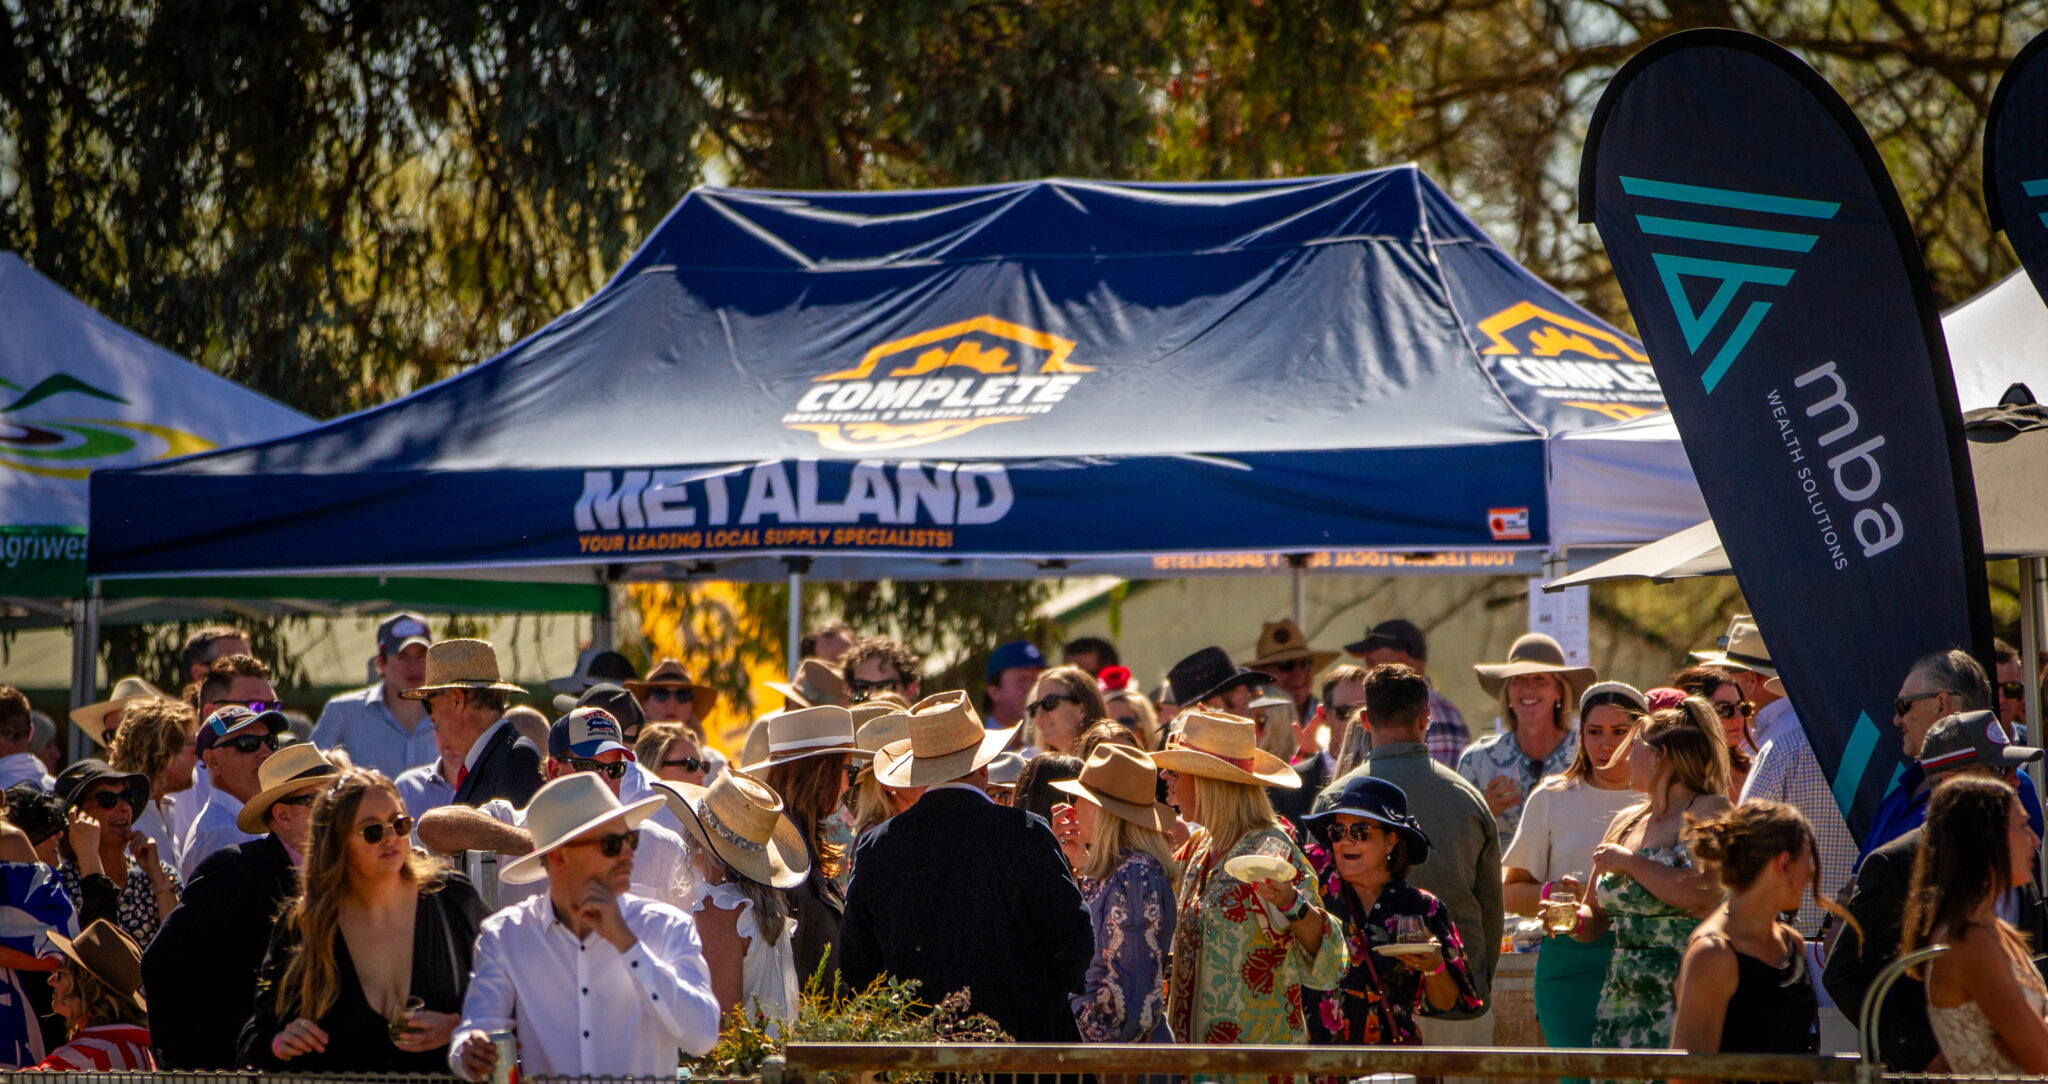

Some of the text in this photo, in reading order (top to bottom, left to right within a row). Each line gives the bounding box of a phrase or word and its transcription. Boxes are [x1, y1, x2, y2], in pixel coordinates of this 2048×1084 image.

[796, 374, 1081, 412] COMPLETE
[1767, 388, 1848, 571] WEALTH SOLUTIONS
[1794, 360, 1904, 558] mba
[574, 457, 1015, 532] METALAND
[0, 528, 88, 569] griwes
[579, 527, 953, 553] YOUR LEADING LOCAL SUPPLY SPECIALISTS!
